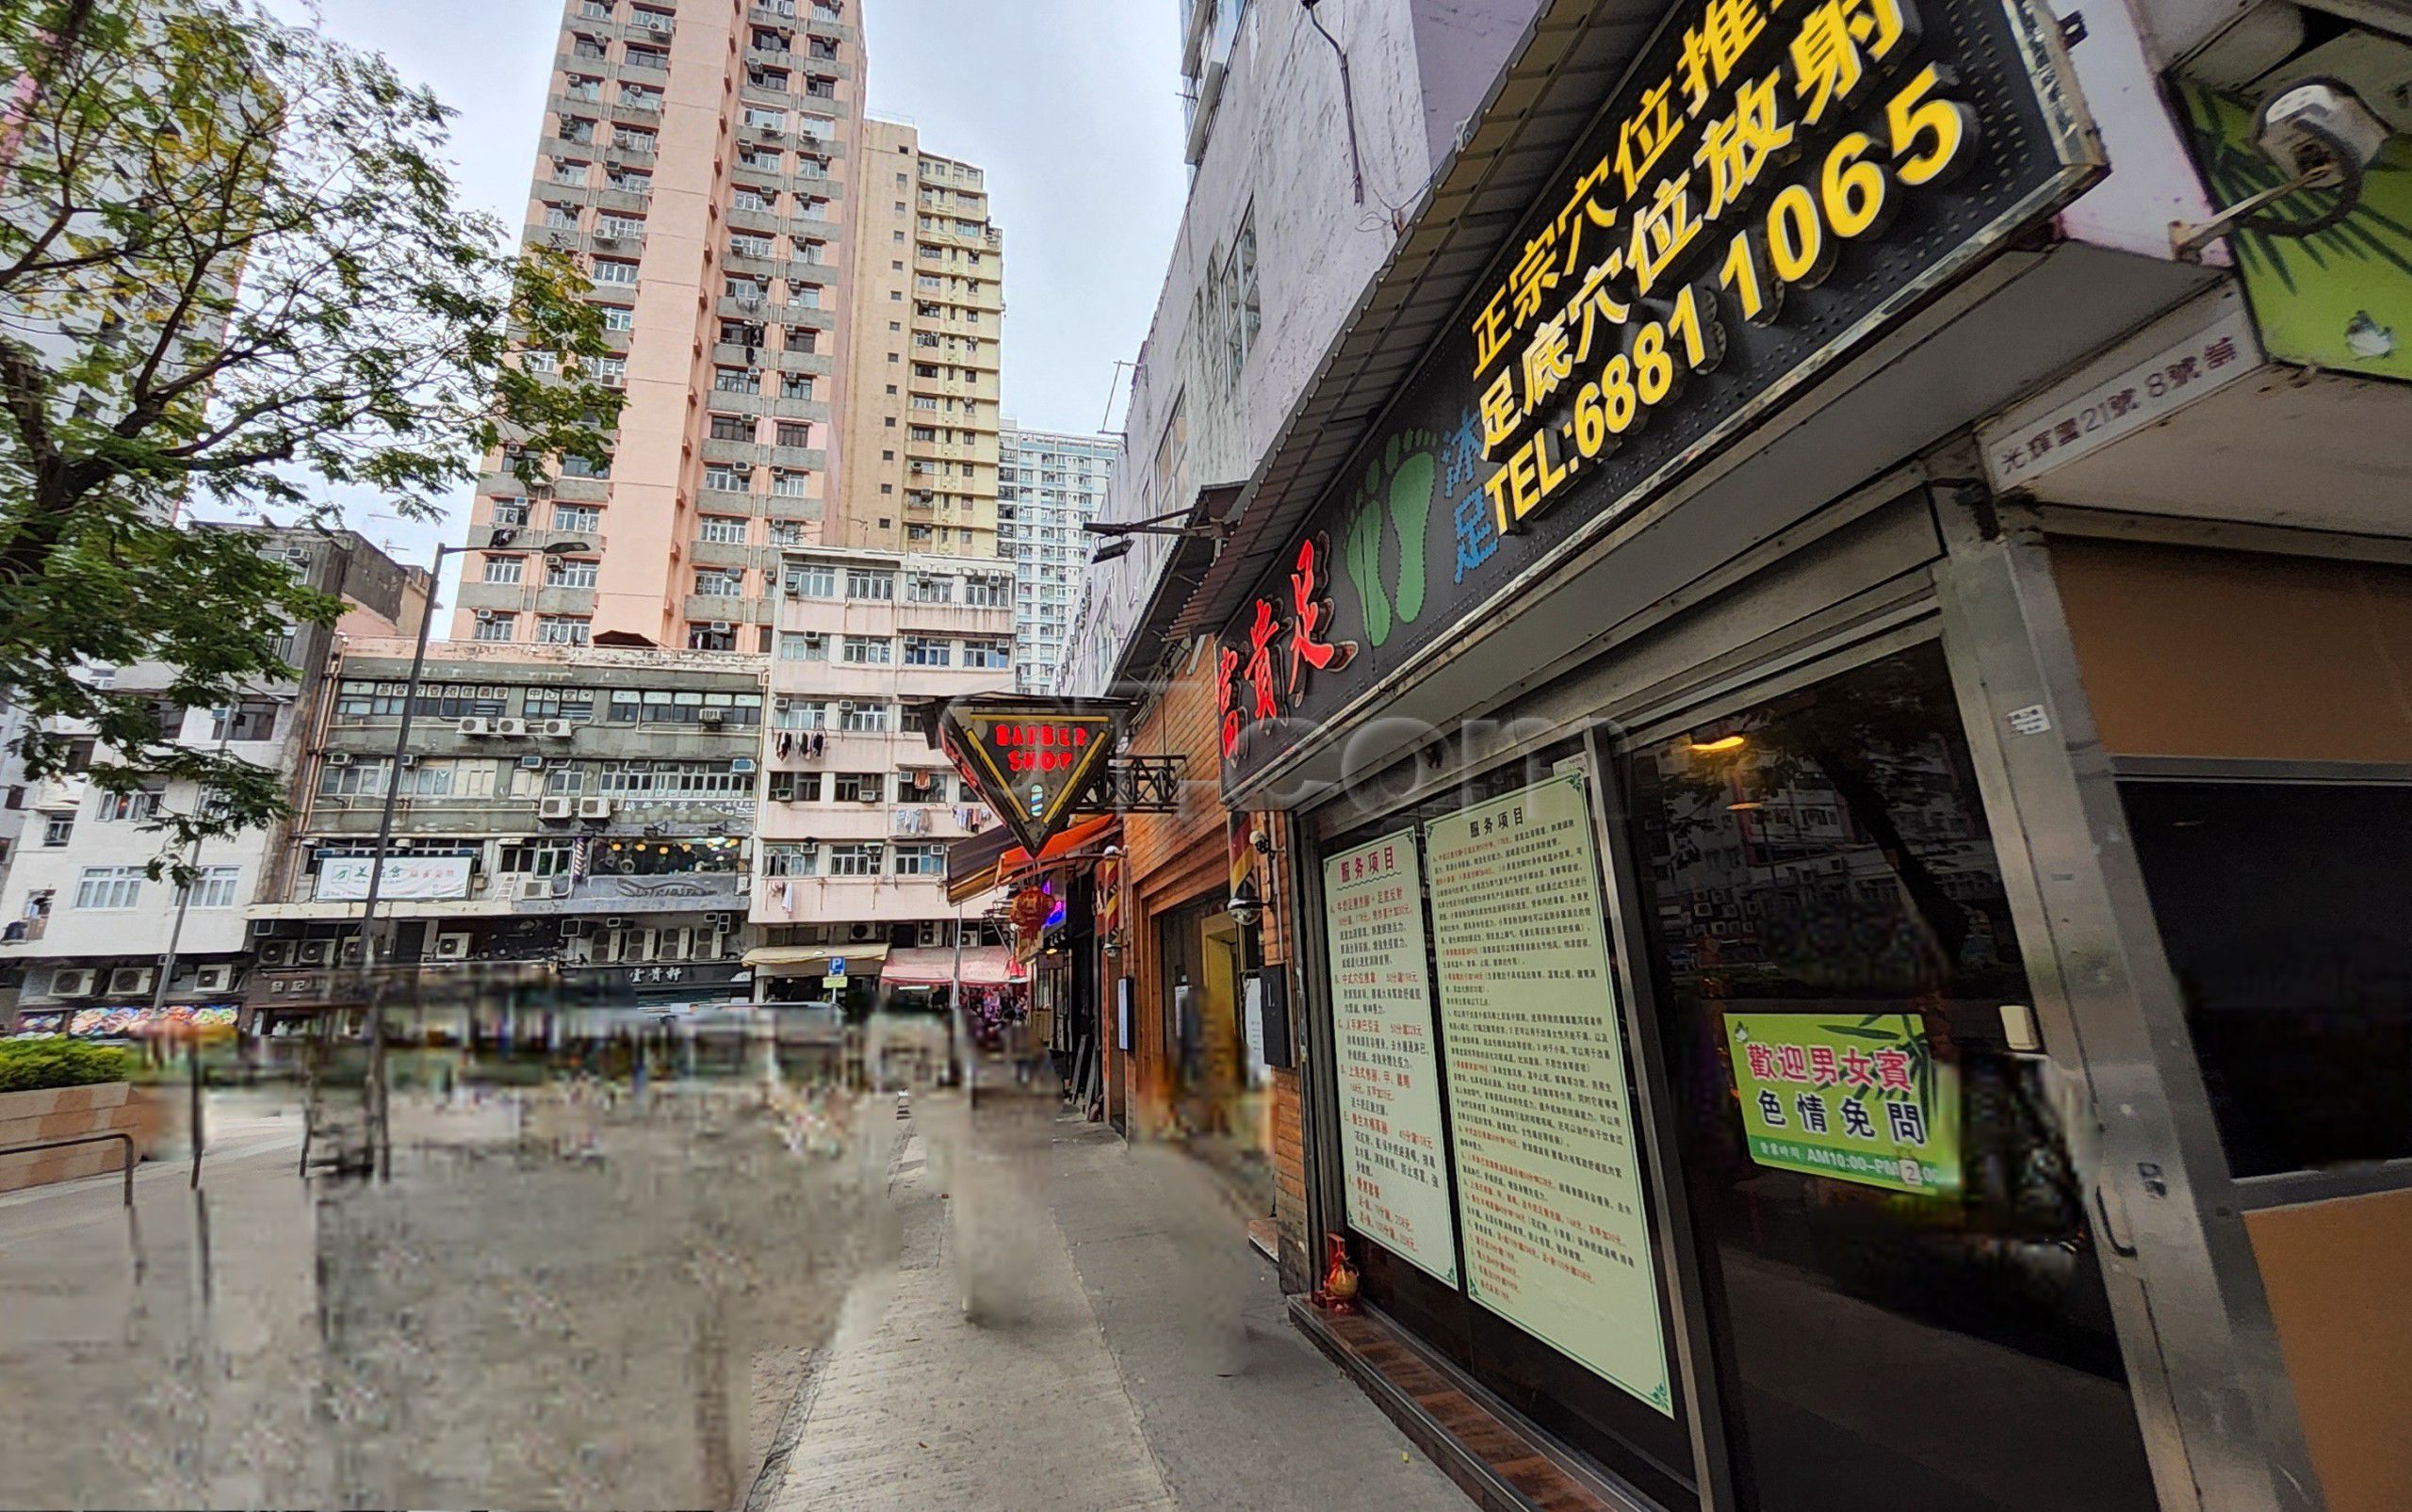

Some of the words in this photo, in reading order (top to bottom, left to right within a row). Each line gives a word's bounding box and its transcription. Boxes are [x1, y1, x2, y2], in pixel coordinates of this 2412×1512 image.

[1474, 0, 1790, 379] 正宗穴位推
[1719, 63, 1964, 322] 1065
[1746, 1043, 1913, 1094] 歡迎男女賓
[1757, 1089, 1926, 1146] 色情免問
